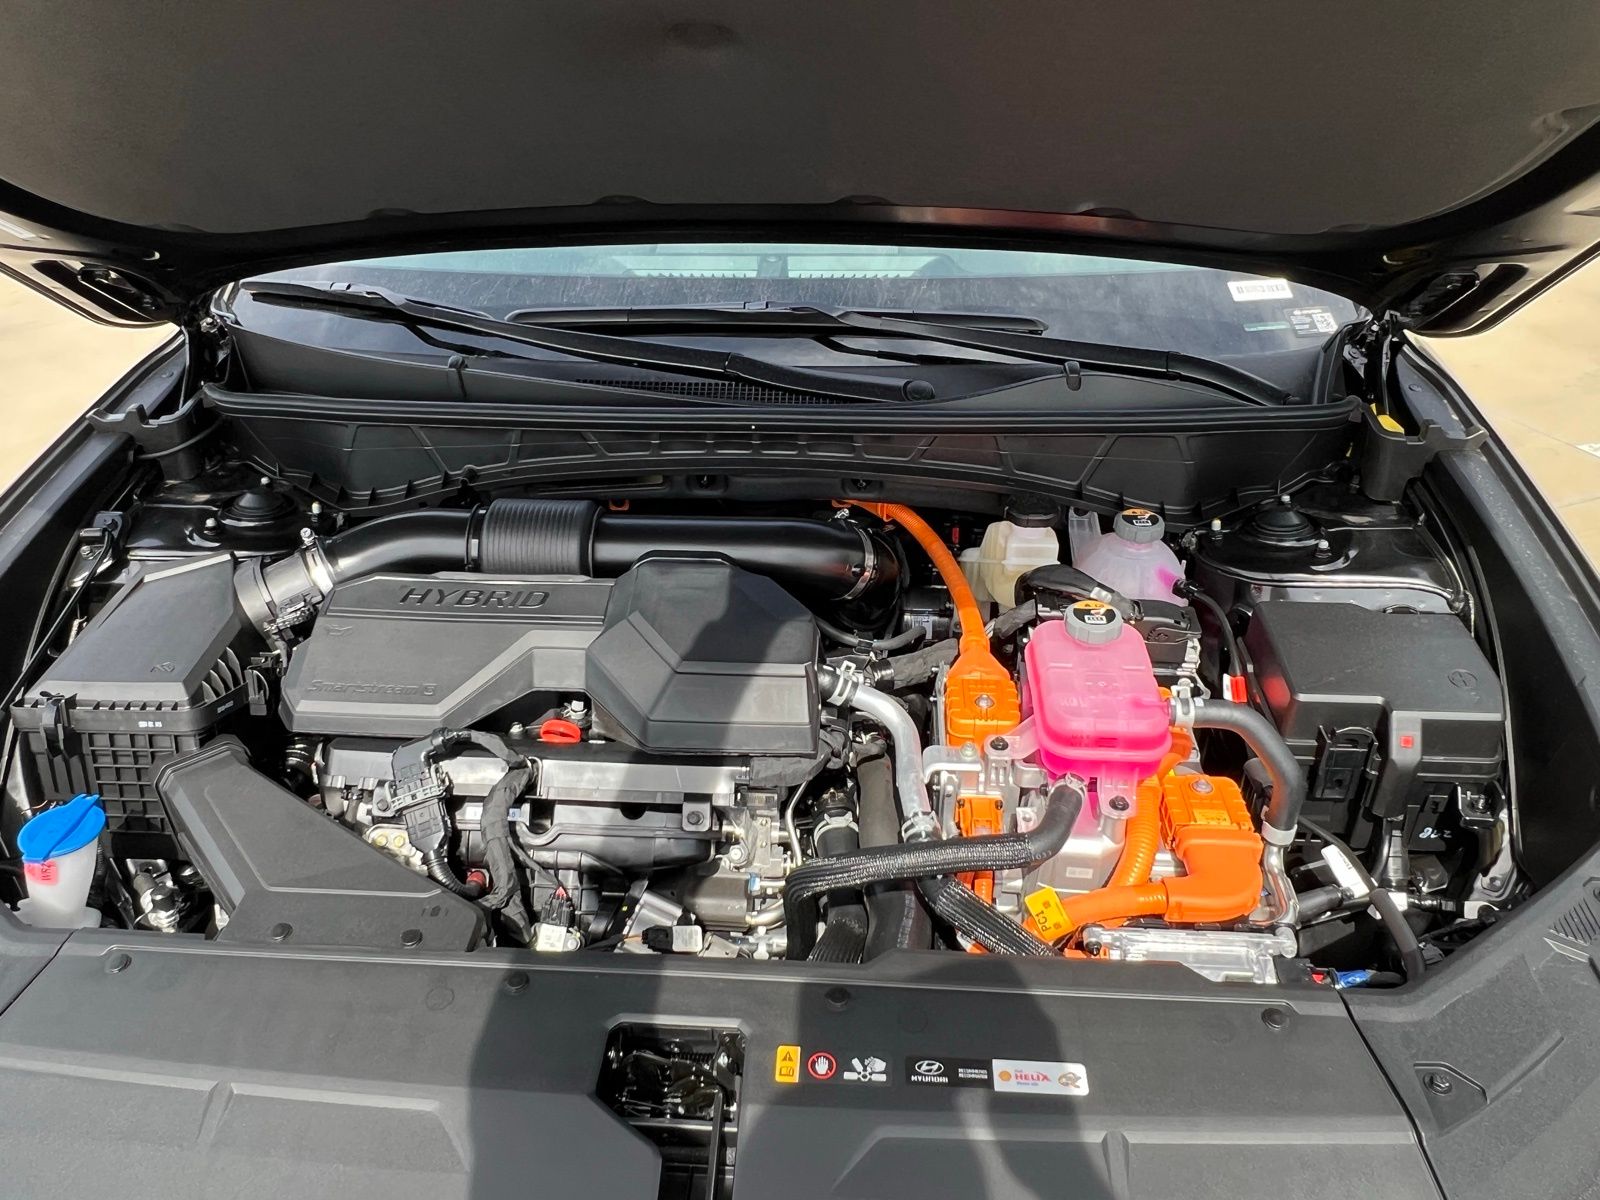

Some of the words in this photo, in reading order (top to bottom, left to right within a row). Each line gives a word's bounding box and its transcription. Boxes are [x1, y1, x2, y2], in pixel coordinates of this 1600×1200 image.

[399, 587, 551, 609] HYBRID
[910, 1075, 948, 1083] HYUNDAI
[1015, 1071, 1052, 1082] HELIX
